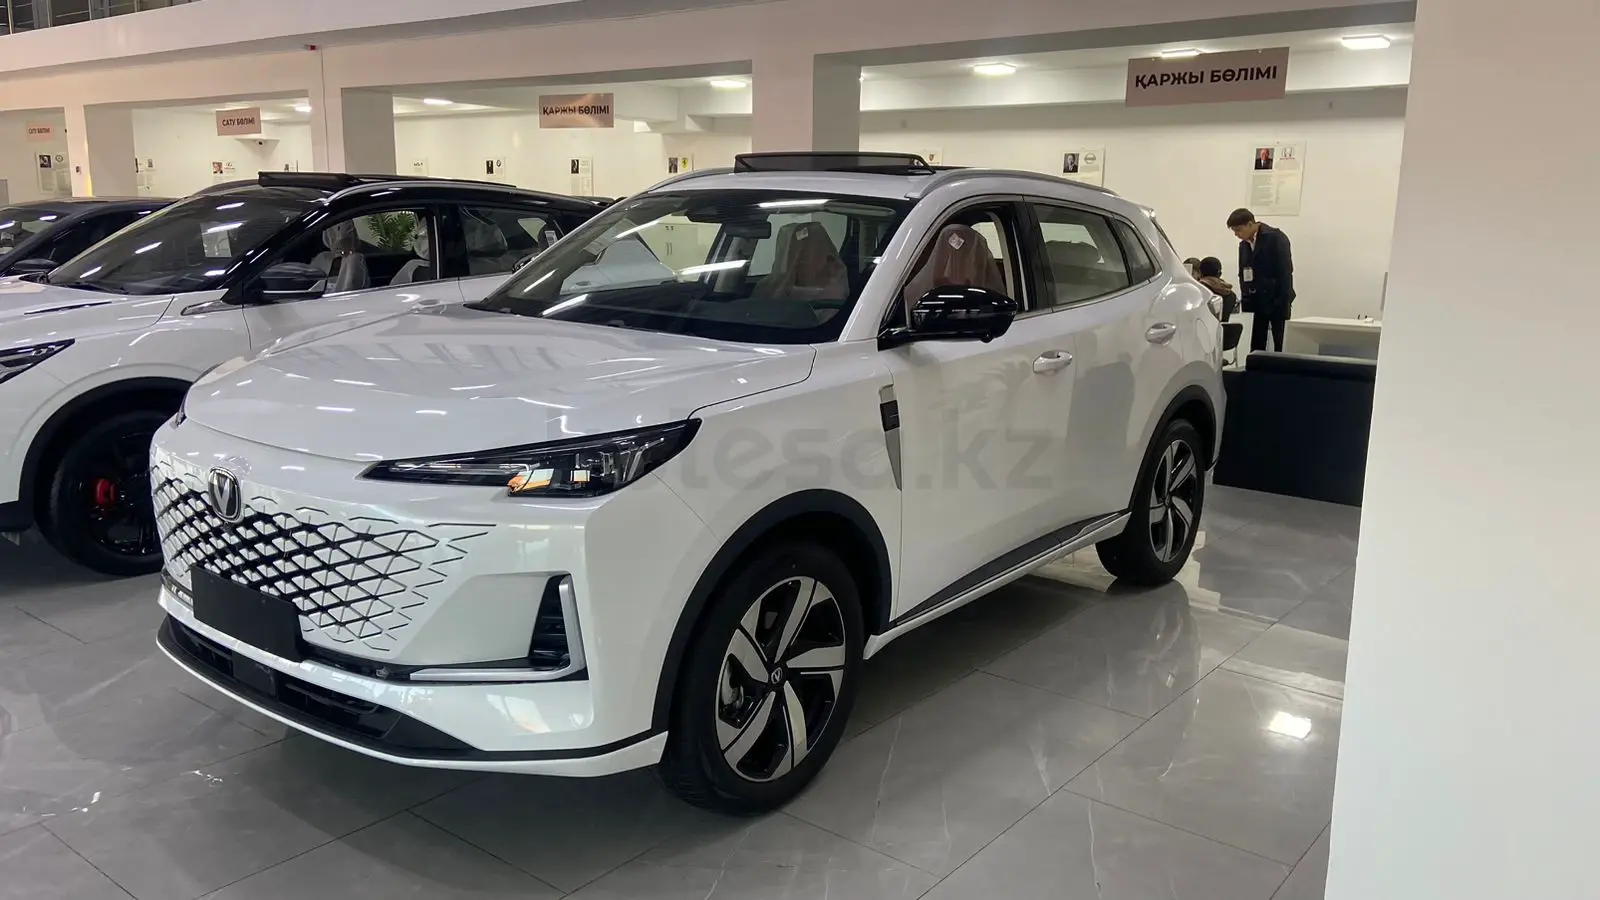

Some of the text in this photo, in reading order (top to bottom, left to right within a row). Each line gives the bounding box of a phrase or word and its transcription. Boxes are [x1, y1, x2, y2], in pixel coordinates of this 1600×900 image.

[1135, 66, 1278, 89] ҚАРЖЫ БӨЛІМІ
[543, 105, 610, 116] ҚАРЖЫ БӨЛІМІ
